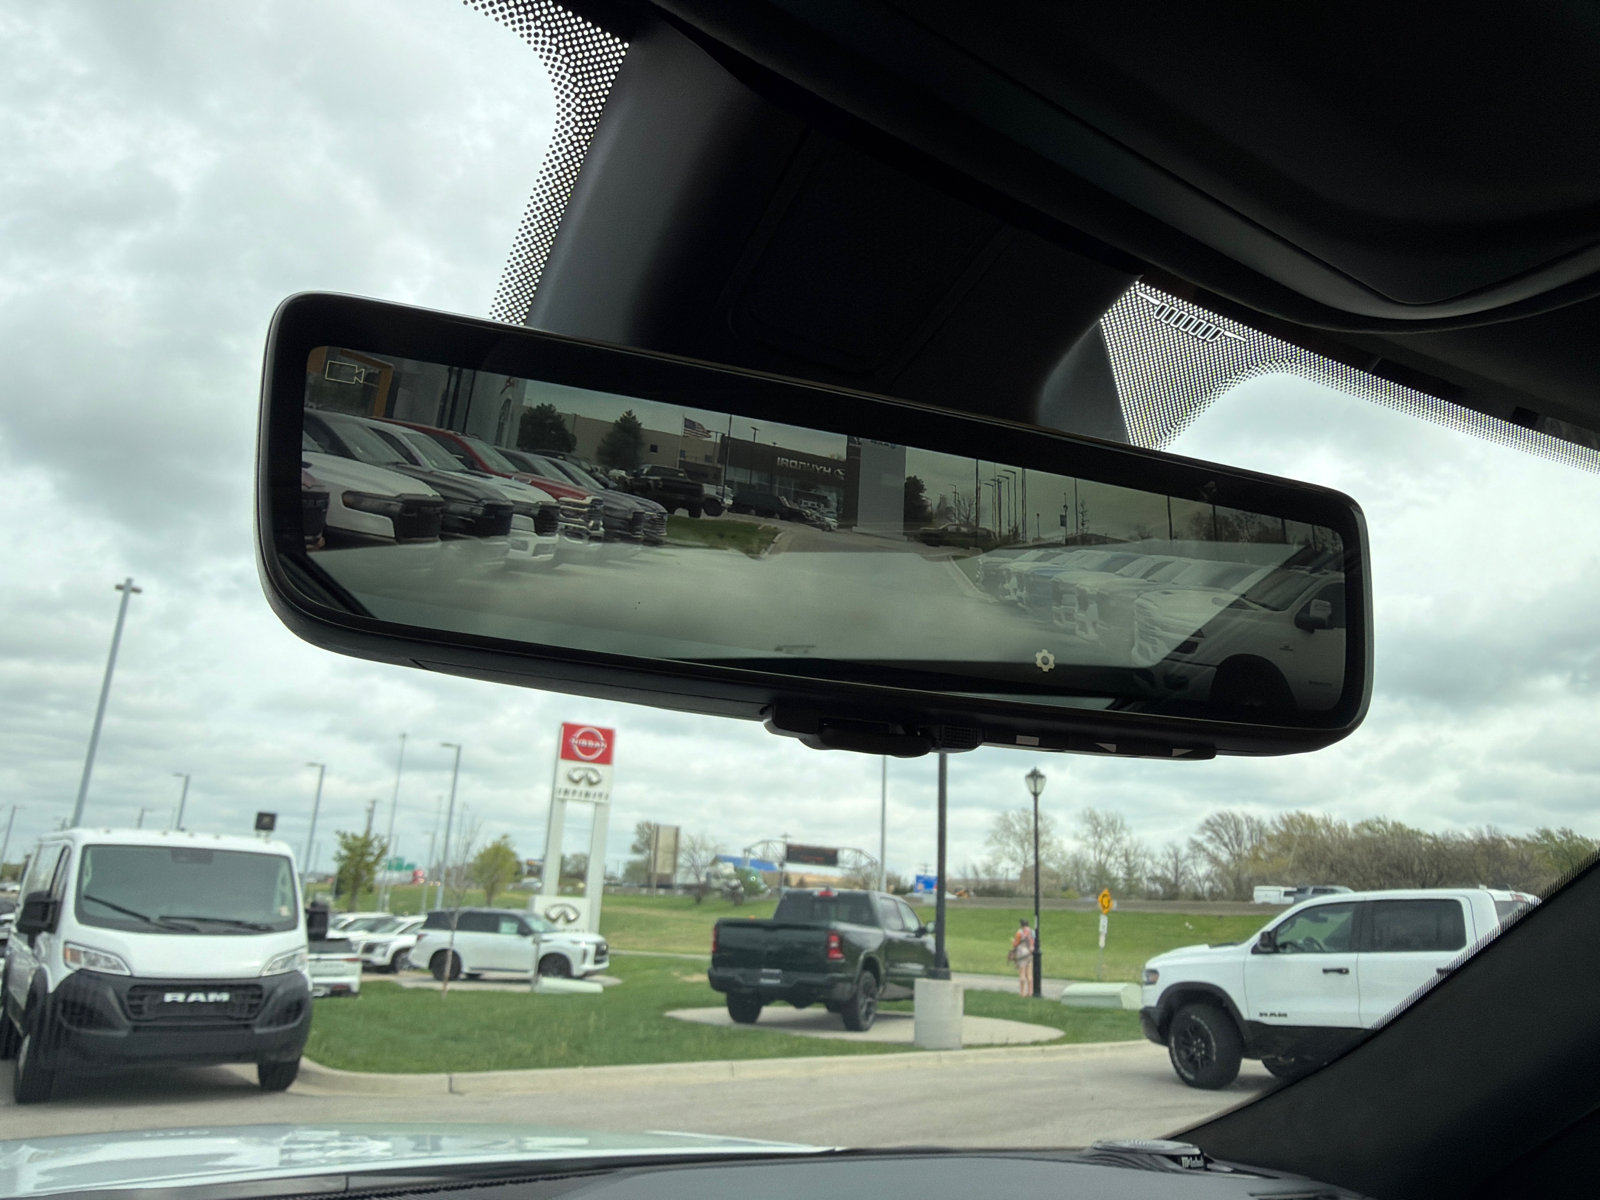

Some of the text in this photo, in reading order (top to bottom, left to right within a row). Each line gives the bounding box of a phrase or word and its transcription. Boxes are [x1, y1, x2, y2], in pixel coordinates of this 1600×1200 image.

[571, 738, 607, 749] NISSAN
[558, 788, 609, 801] INFINITI
[163, 992, 230, 1003] RAM
